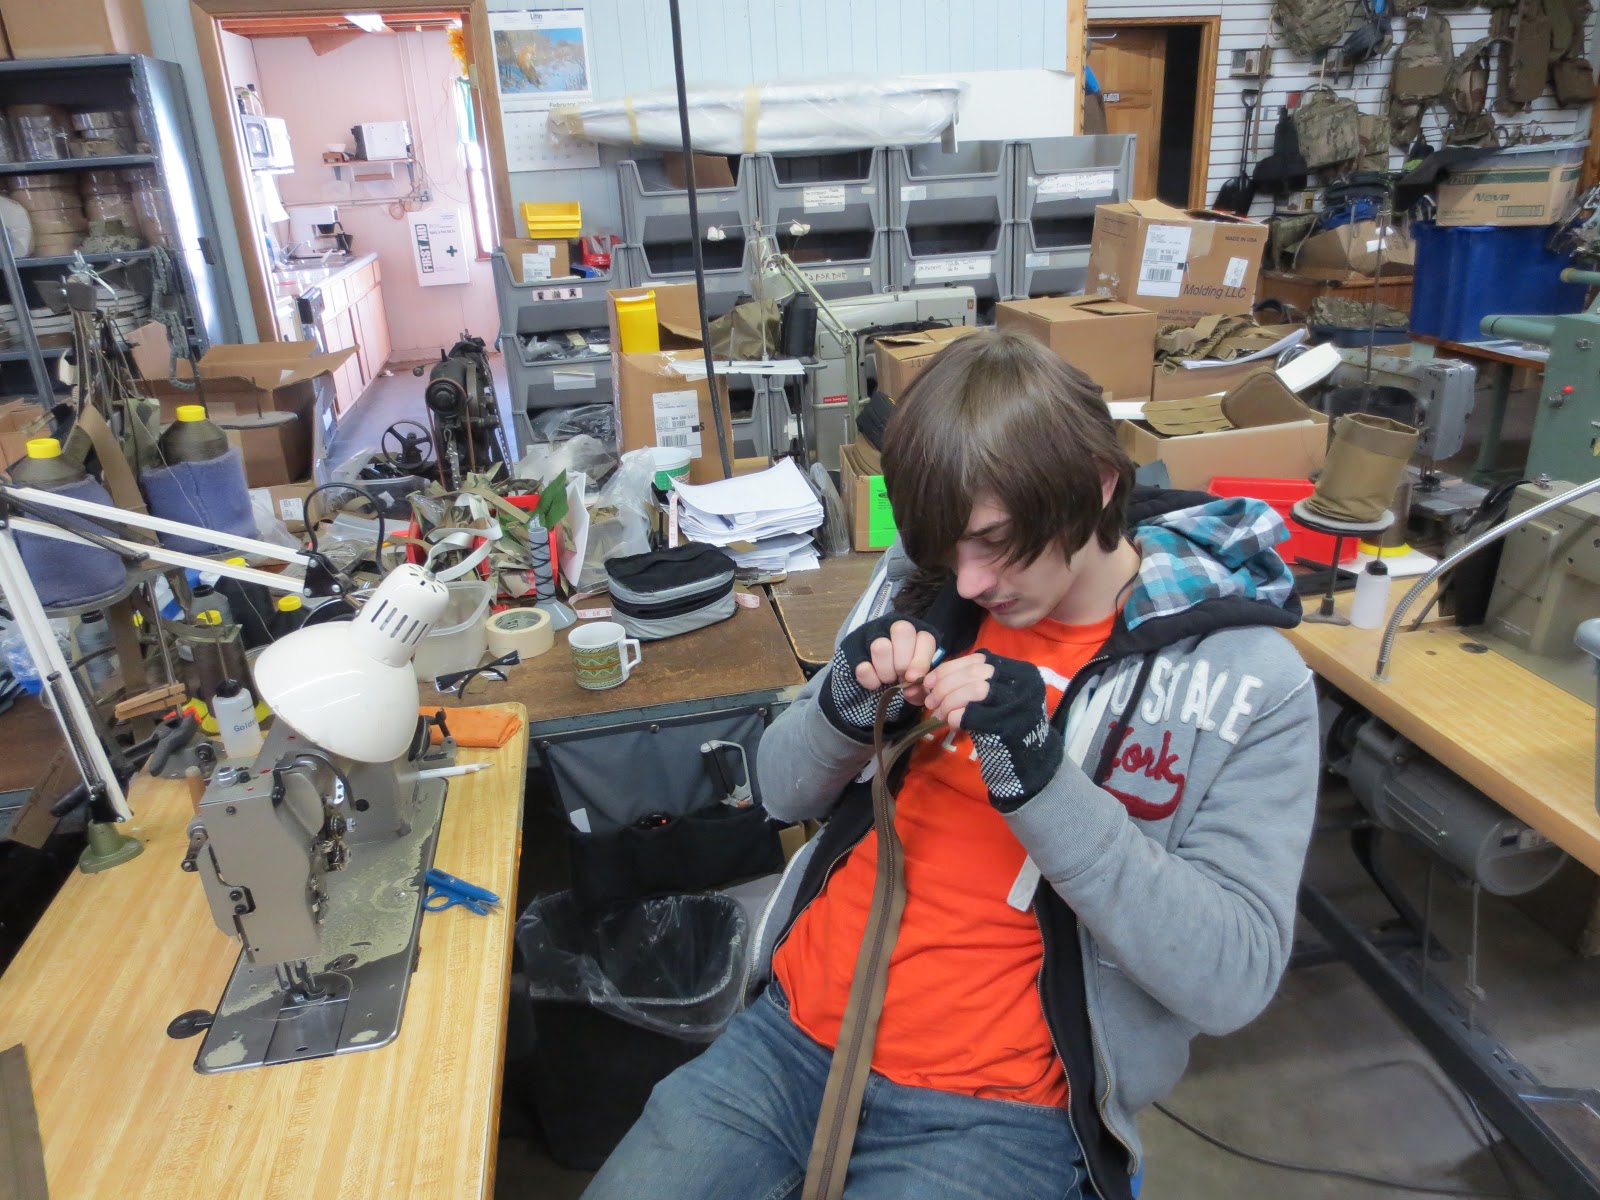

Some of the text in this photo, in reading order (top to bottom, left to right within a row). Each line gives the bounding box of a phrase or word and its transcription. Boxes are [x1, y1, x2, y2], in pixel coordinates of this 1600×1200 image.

[416, 225, 434, 272] FIRST AID
[1183, 283, 1247, 299] Molding LLC
